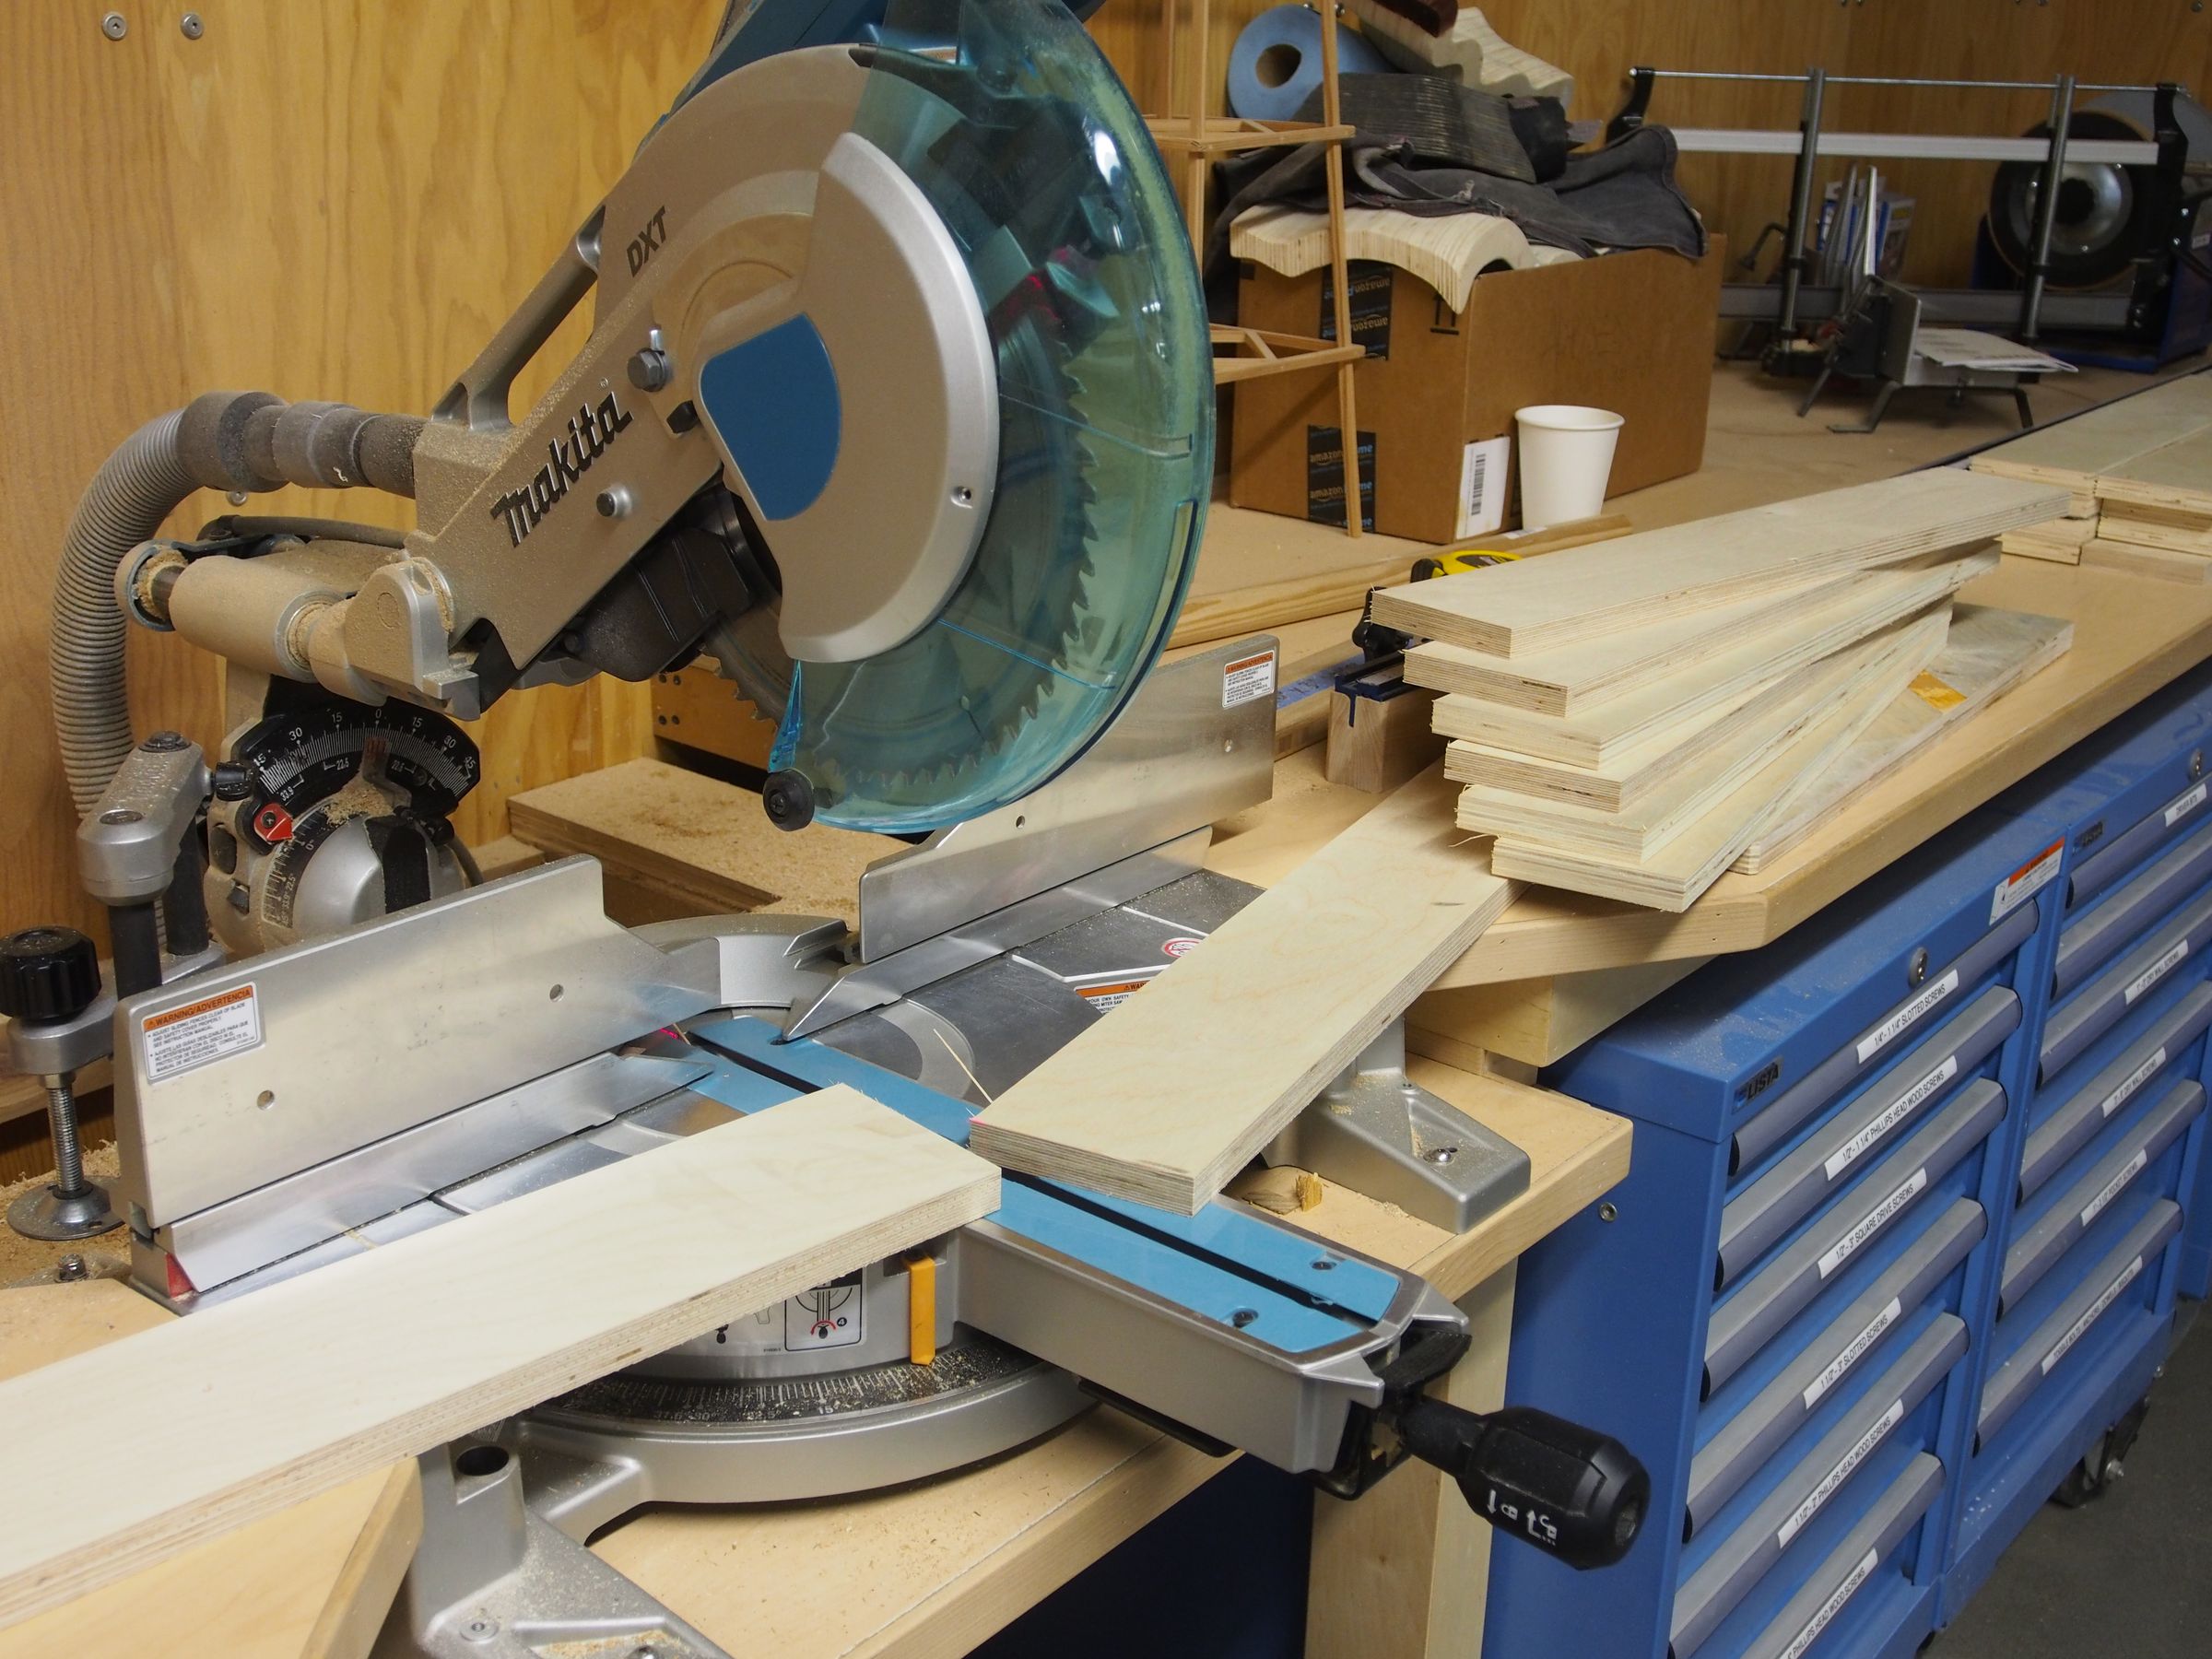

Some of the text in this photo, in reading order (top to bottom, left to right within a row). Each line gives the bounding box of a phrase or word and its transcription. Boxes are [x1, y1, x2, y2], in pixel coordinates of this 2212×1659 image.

[627, 206, 666, 277] DXT
[1310, 486, 1344, 499] amazon
[289, 727, 303, 741] 30
[332, 712, 343, 724] 15
[375, 709, 382, 719] 0
[412, 717, 423, 728] 15
[443, 735, 456, 748] 30
[152, 1027, 170, 1036] ADJUST
[171, 1021, 188, 1030] SLIDING
[190, 1015, 206, 1024] FENCES
[208, 1009, 222, 1018] CLEAR
[156, 988, 250, 1026] WARNING/ADVERTENCIA
[1901, 1001, 1924, 1025] SLOTTED
[1924, 983, 1946, 1007] SCREWS
[163, 1030, 193, 1044] INSTRUCTION
[164, 1030, 181, 1038] SAFETY
[182, 1024, 196, 1032] COVER
[1747, 1061, 1779, 1101] LISTA
[1870, 1113, 1894, 1140] PHILLIPS
[1893, 1100, 1908, 1122] HEAD
[1908, 1088, 1924, 1106] WOOD
[1924, 1070, 1945, 1095] SCREWS
[1854, 1217, 1877, 1243] SQUARE
[1877, 1203, 1893, 1223] DRIVE
[1892, 1183, 1914, 1209] SCREWS
[1843, 1336, 1867, 1366] SLOTTED
[1866, 1314, 1888, 1342] SCREWS
[1818, 1471, 1841, 1501] PHILLIPS
[1841, 1455, 1855, 1477] HEAD
[1854, 1438, 1871, 1461] WOOD
[1870, 1416, 1891, 1445] SCREWS
[1792, 1625, 1816, 1654] PHILLIPS
[1815, 1608, 1830, 1630] HEAD
[1829, 1590, 1844, 1614] WOOD
[1844, 1567, 1865, 1596] SCREWS
